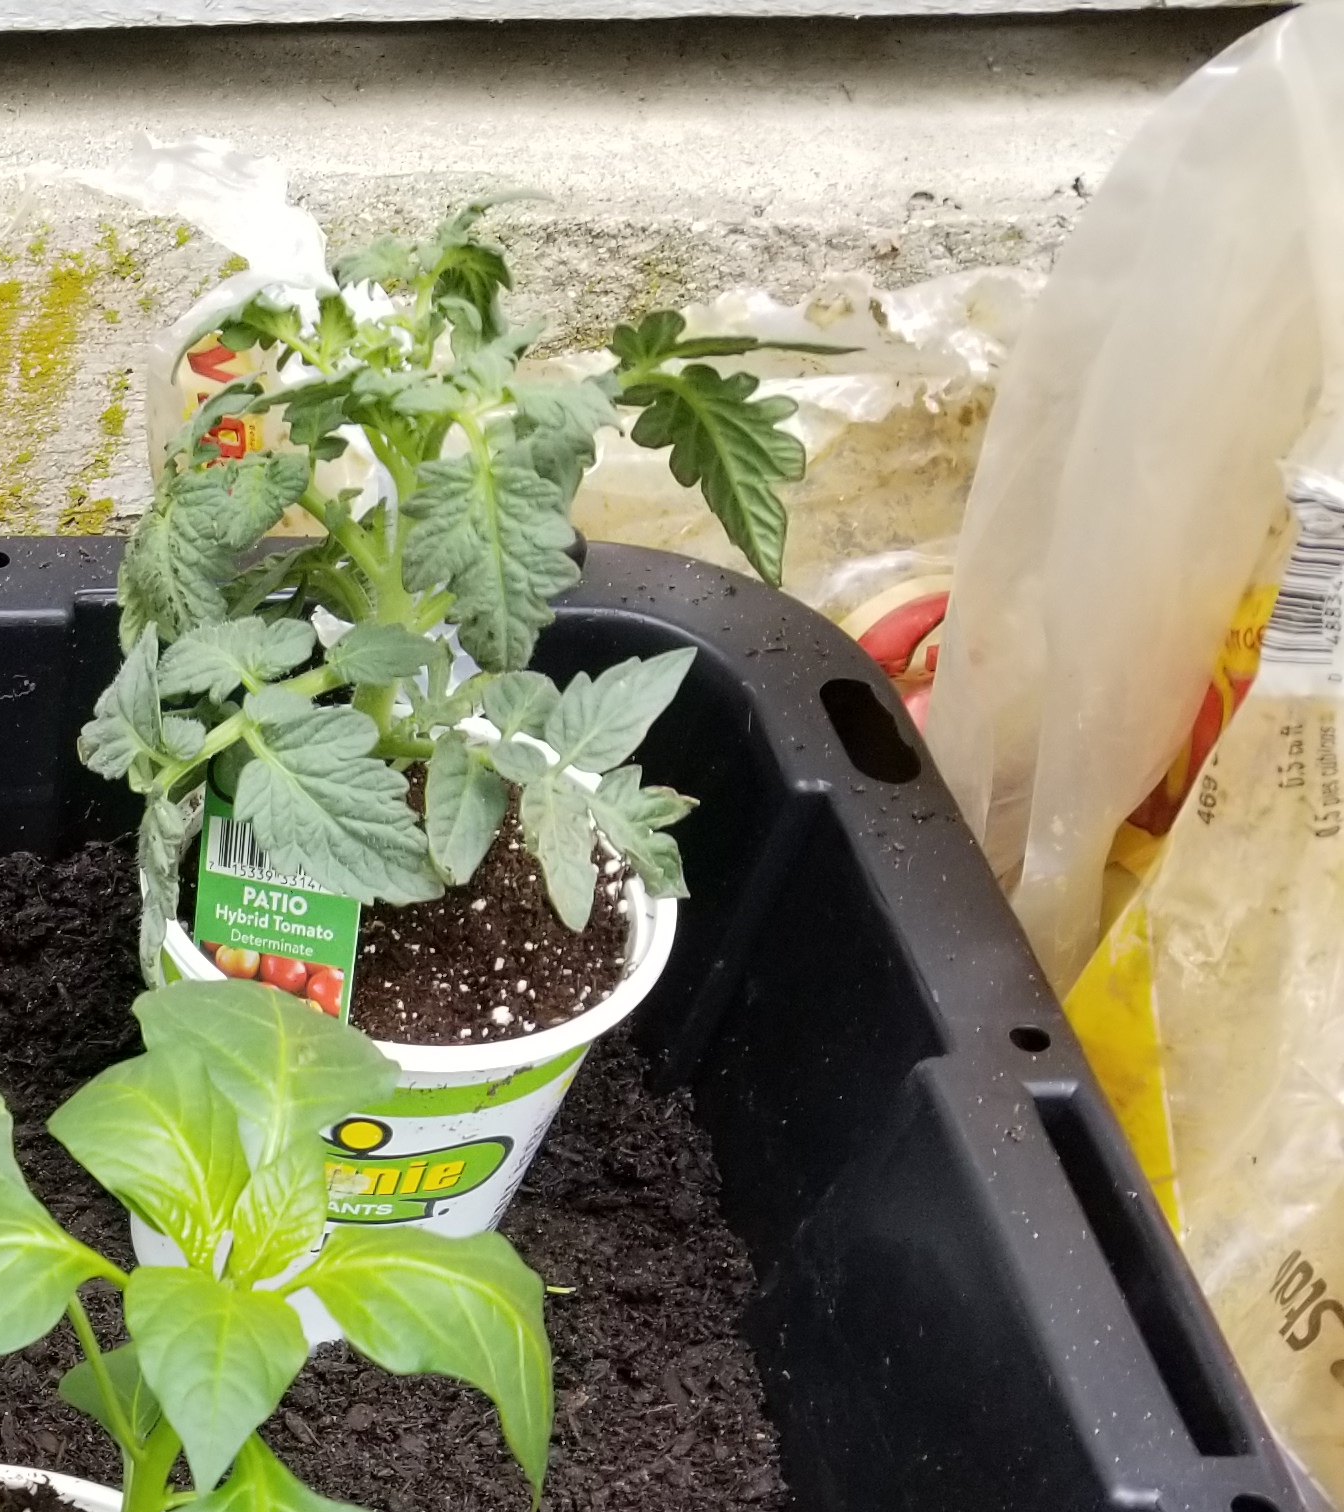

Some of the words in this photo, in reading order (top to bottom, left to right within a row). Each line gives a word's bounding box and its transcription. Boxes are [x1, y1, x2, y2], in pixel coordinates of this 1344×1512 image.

[232, 863, 273, 882] 15339
[242, 885, 308, 916] PATIO
[215, 903, 269, 926] Hybrid
[273, 914, 334, 941] Tomato
[230, 928, 314, 957] Determinate
[323, 1161, 465, 1196] nnie
[327, 1203, 394, 1216] ANTS
